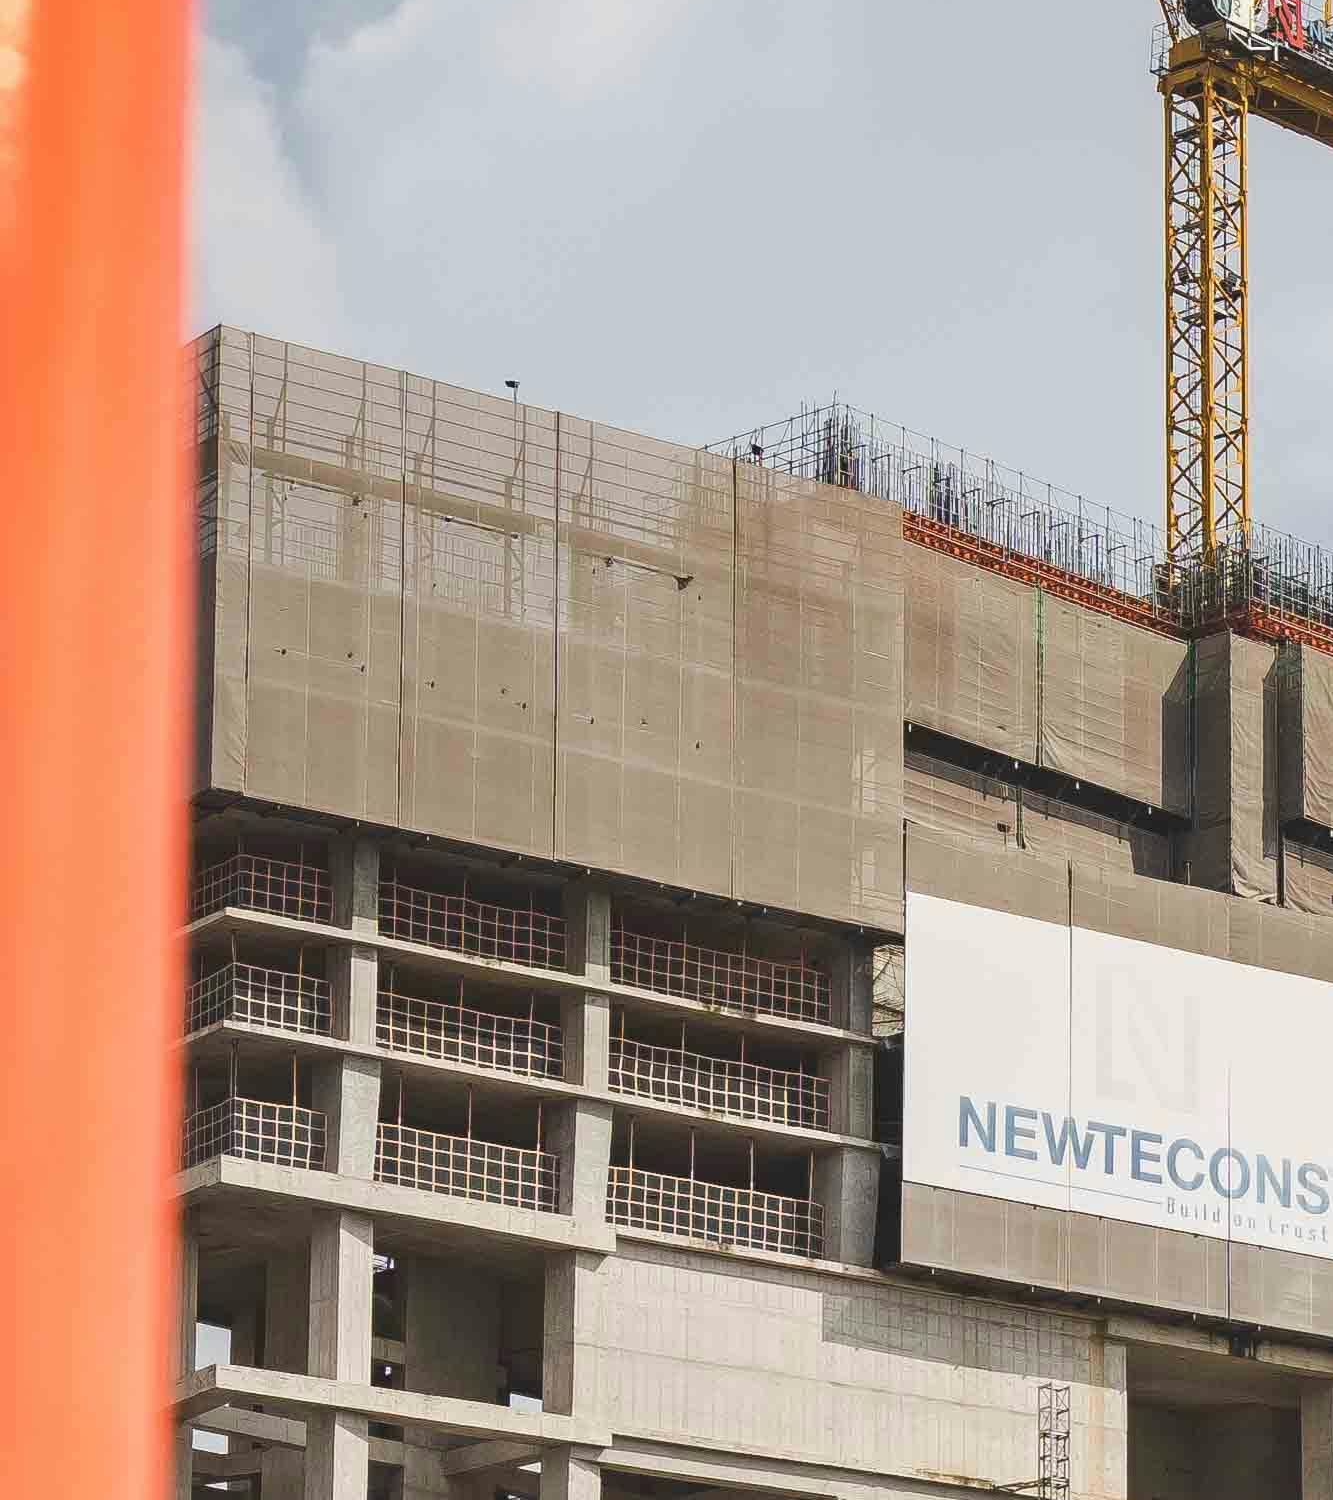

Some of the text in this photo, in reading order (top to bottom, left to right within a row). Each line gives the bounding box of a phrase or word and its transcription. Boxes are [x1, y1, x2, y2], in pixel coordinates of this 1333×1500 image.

[959, 1095, 1330, 1214] NEWTECONS
[1167, 1196, 1329, 1243] Build on trust
